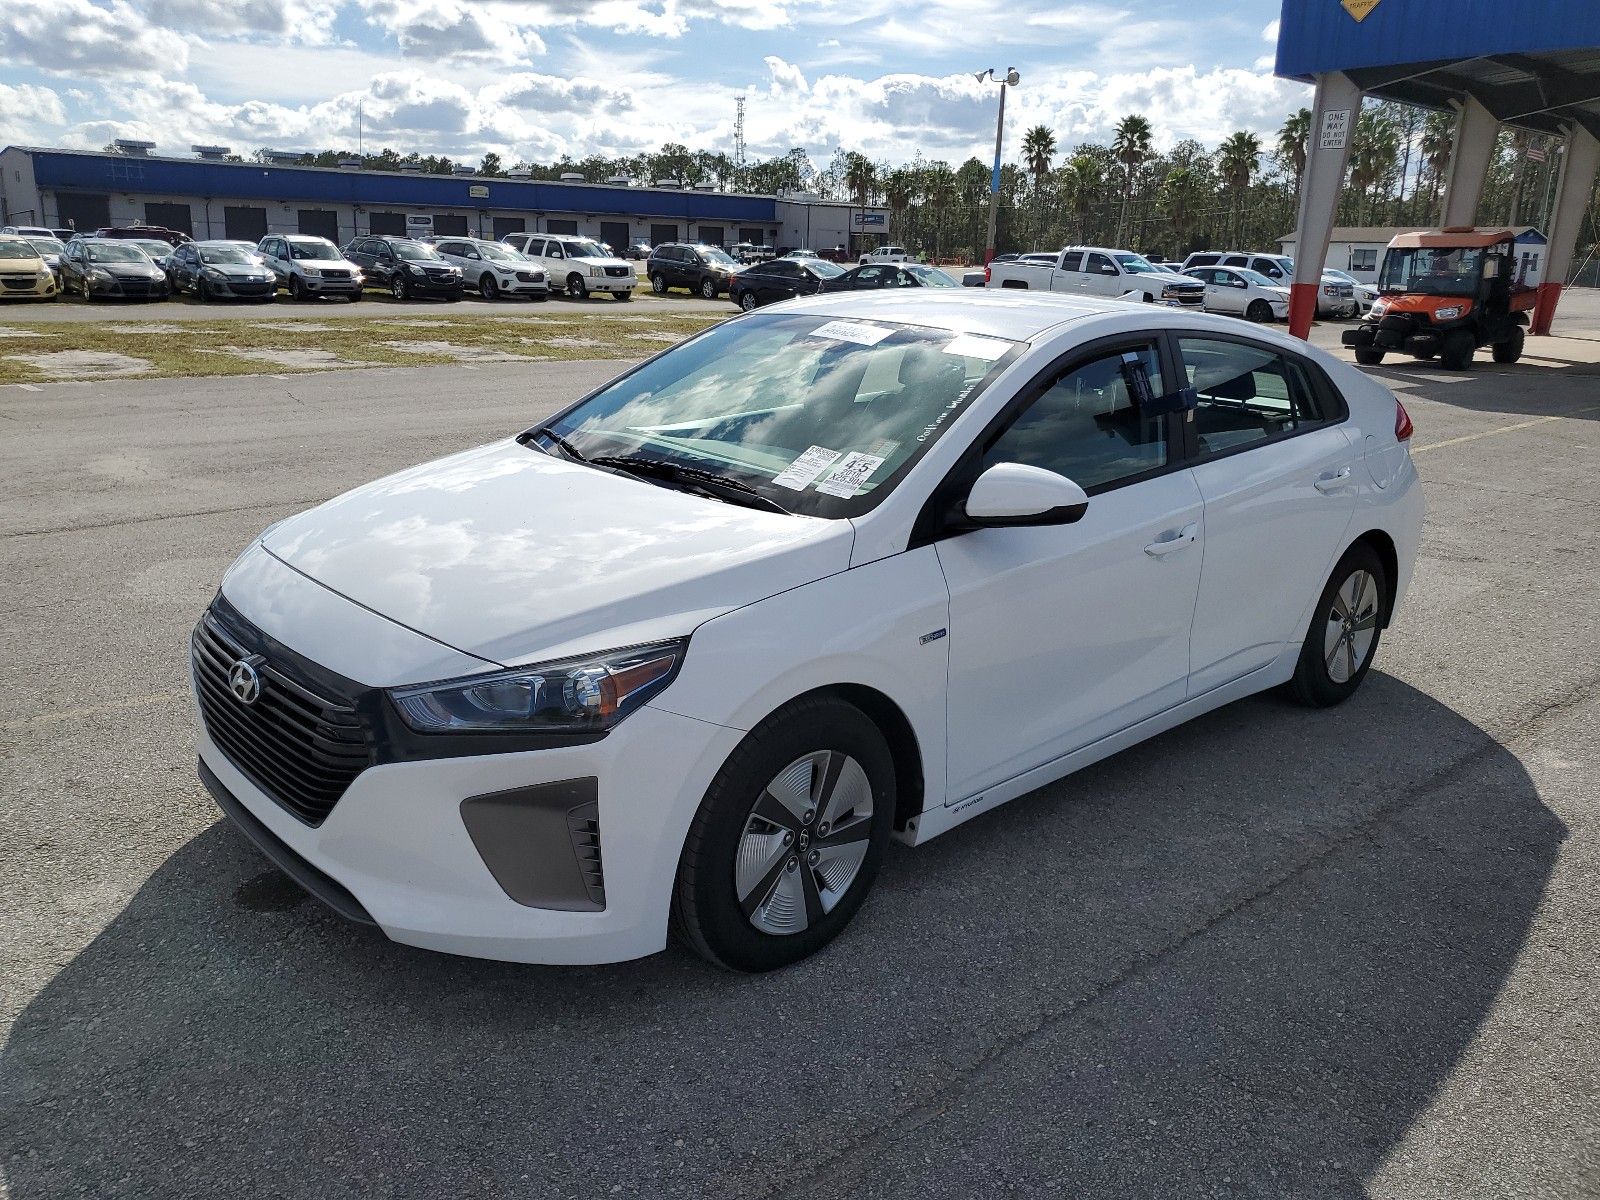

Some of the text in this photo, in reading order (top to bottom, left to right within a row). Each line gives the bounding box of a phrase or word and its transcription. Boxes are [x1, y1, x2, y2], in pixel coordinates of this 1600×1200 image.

[1349, 1, 1374, 9] TRAFFIC
[1328, 112, 1346, 121] ONE
[1327, 122, 1345, 130] WAY
[1323, 139, 1343, 147] ENTER
